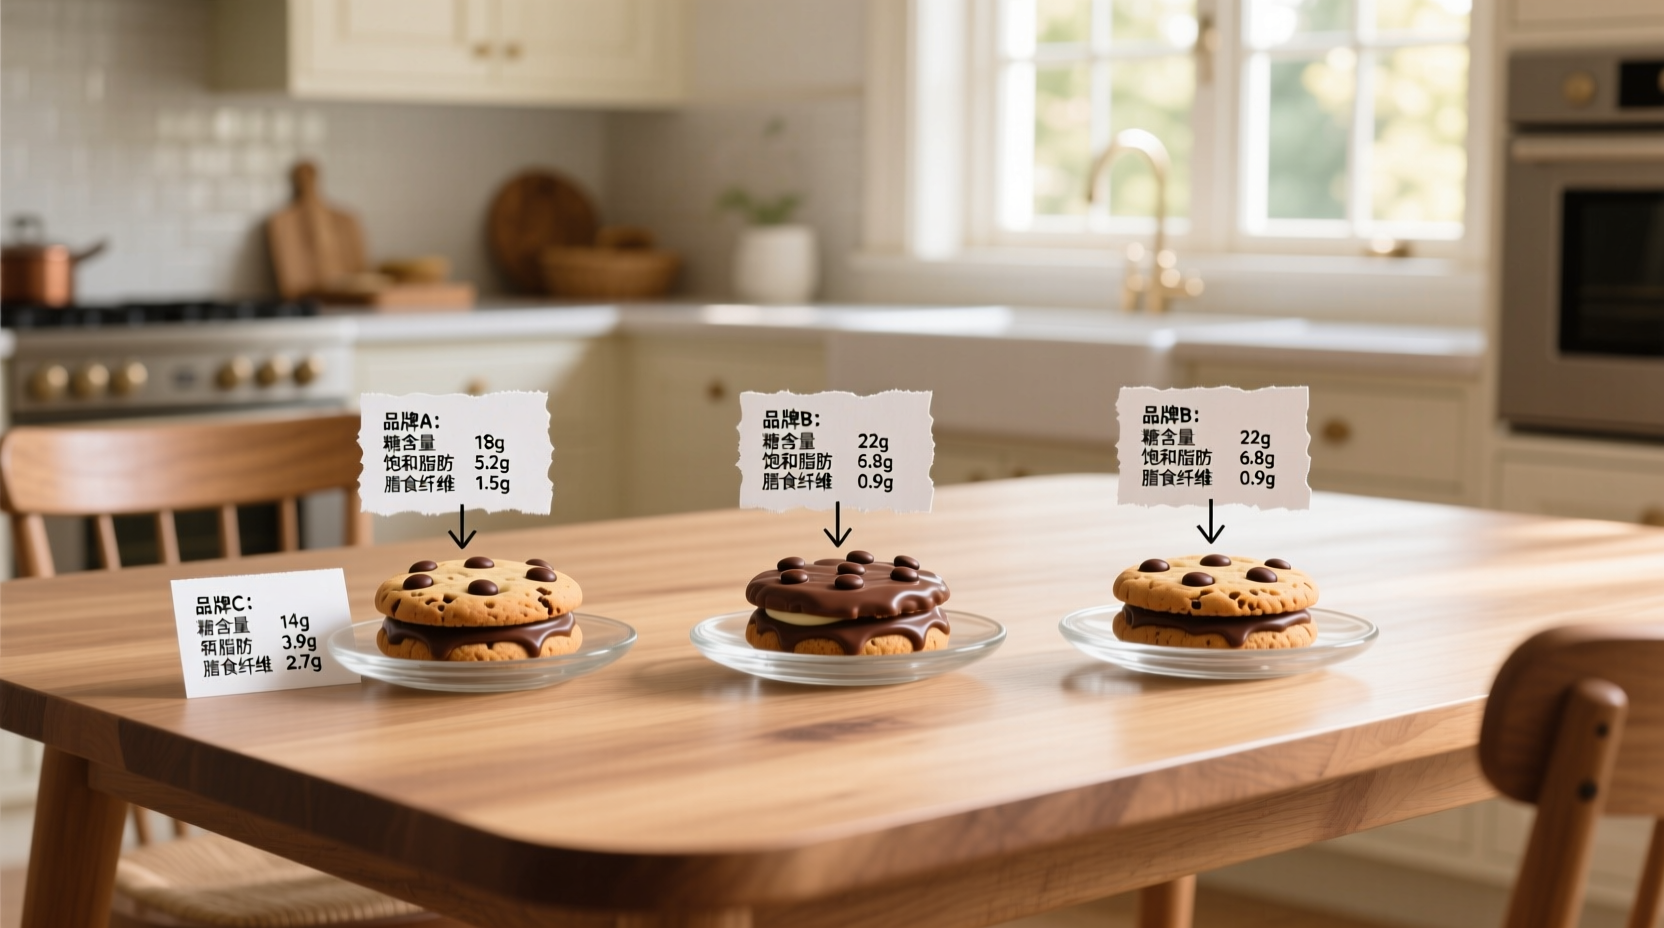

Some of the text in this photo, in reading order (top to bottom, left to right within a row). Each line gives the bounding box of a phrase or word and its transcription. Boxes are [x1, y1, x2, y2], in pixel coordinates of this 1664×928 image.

[383, 411, 440, 432] 品牌A：
[762, 408, 820, 430] 品牌B：
[1142, 404, 1199, 425] 品牌B：
[474, 433, 505, 454] 18g
[857, 432, 889, 453] 22g
[1240, 429, 1271, 450] 22g
[383, 453, 510, 474] 饱和脂肪 5.2g
[761, 451, 893, 473] 饱和脂肪 6.8g
[1141, 447, 1275, 470] 饱和脂肪 6.8g
[475, 475, 510, 495] 1.5g
[857, 473, 894, 493] 0.9g
[1239, 469, 1276, 490] 0.9g
[195, 595, 253, 616] 品牌C：
[280, 612, 310, 632] 14g
[281, 633, 317, 652] 3.9g
[286, 653, 323, 673] 2.7g
